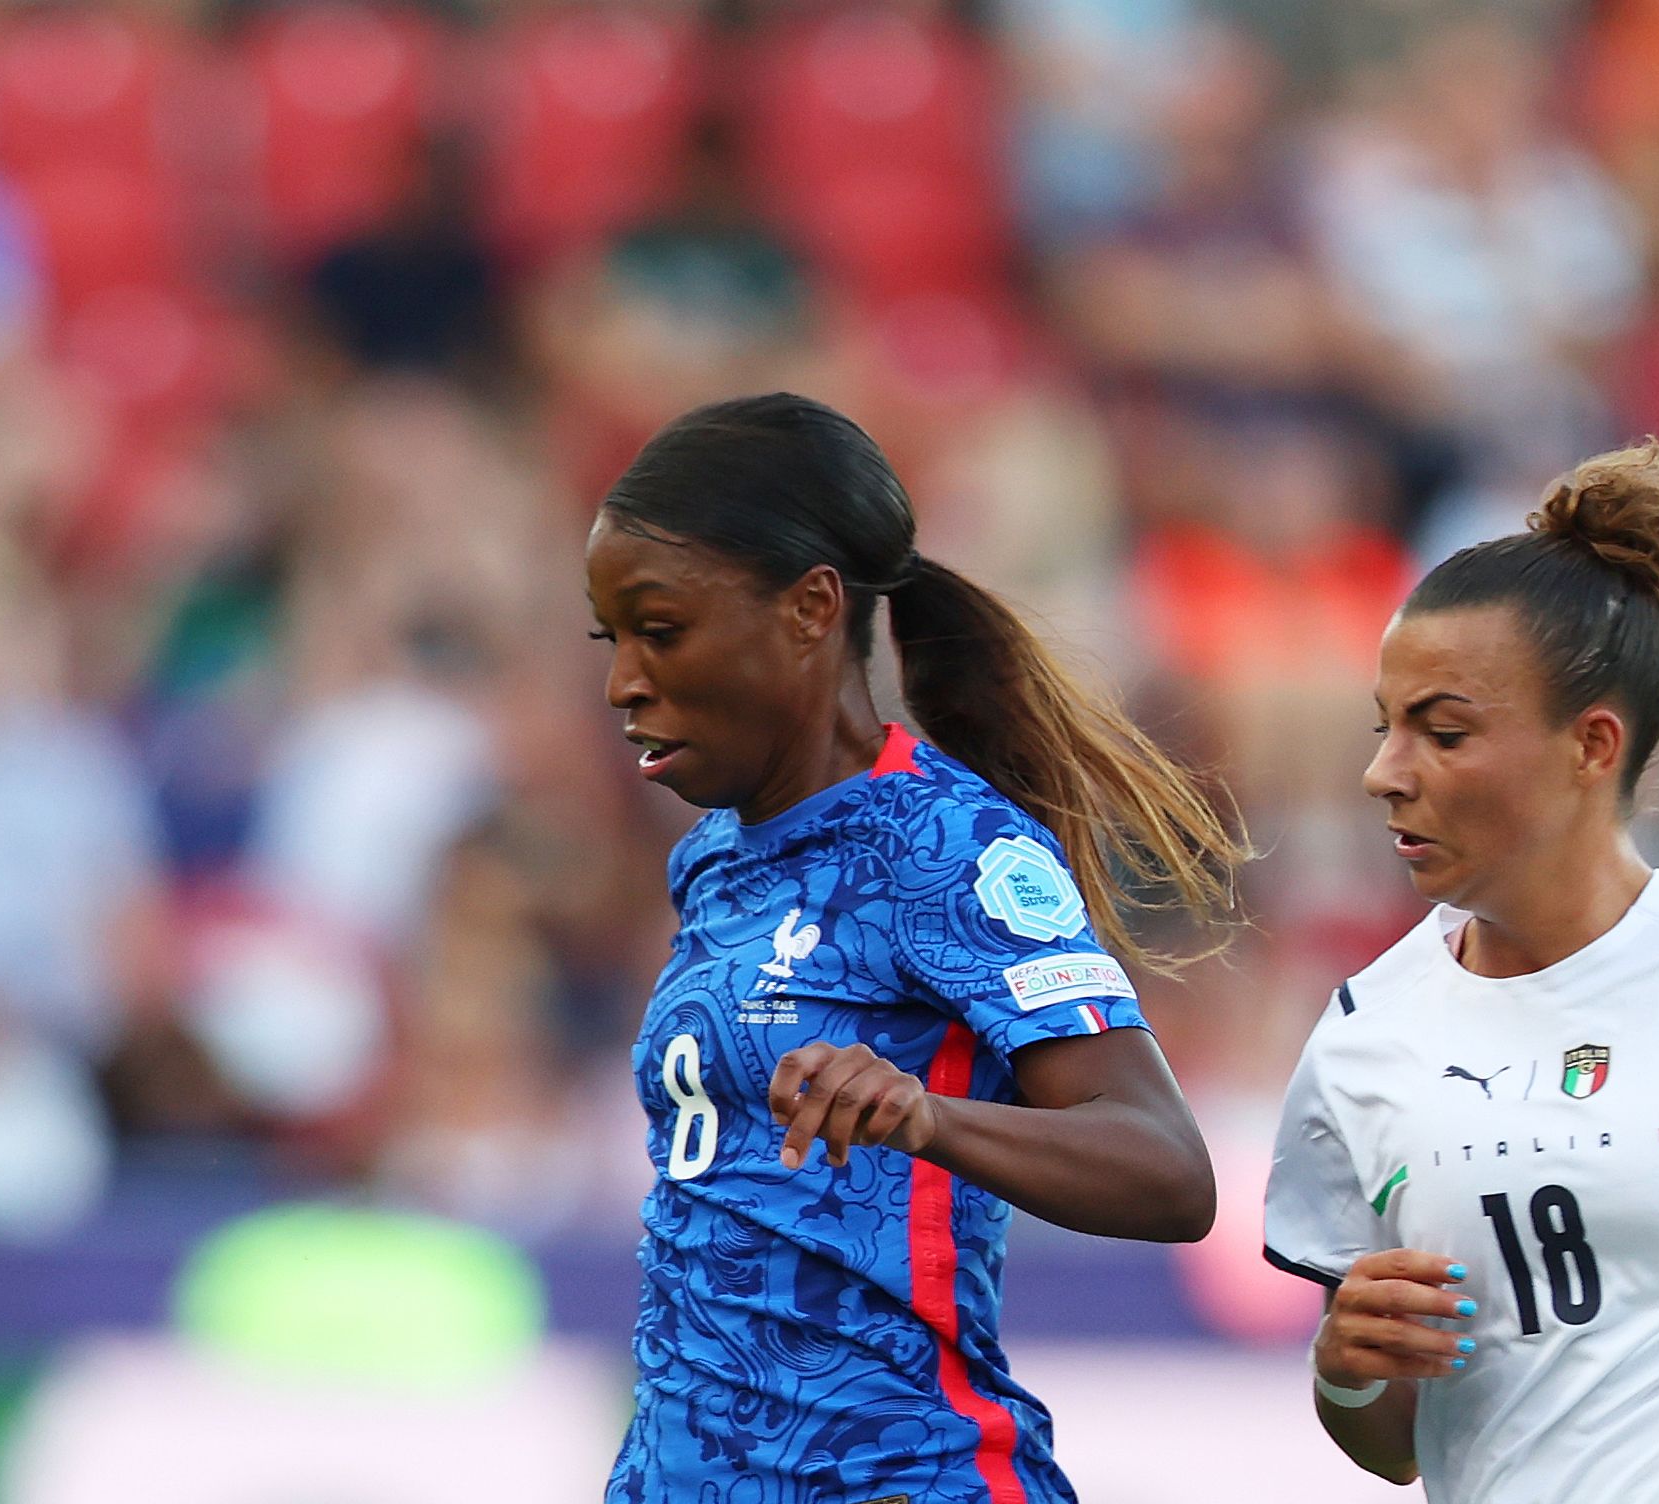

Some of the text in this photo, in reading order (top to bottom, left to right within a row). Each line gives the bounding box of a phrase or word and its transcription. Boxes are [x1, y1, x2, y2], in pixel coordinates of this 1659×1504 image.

[1008, 873, 1028, 883] We
[1020, 895, 1060, 907] Strong
[1010, 965, 1040, 980] UEFA
[755, 979, 789, 993] FFF
[661, 1035, 719, 1181] 8
[1433, 1132, 1613, 1166] ITALIA
[1480, 1184, 1602, 1336] 18
